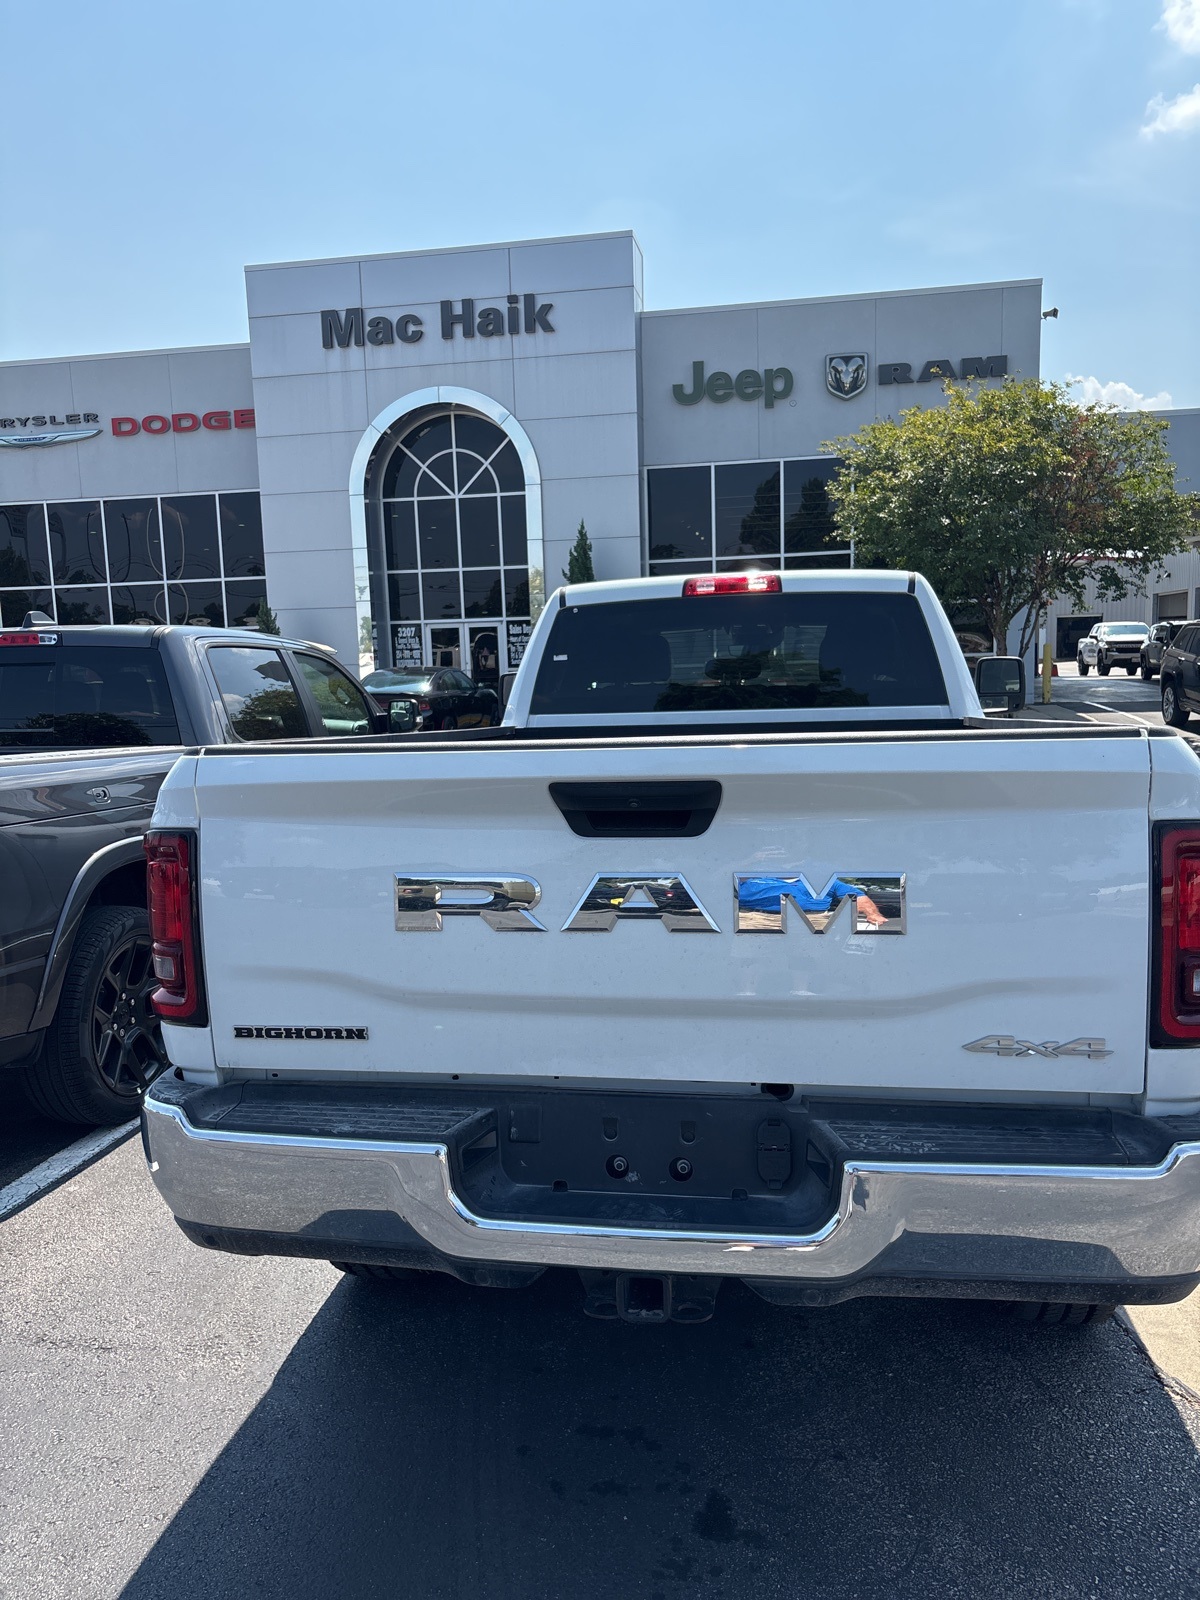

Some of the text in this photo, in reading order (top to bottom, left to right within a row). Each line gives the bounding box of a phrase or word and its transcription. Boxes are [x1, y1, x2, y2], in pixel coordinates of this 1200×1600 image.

[320, 293, 555, 349] Mac Haik
[672, 360, 794, 409] Jeep
[878, 355, 1008, 386] RAM
[111, 408, 255, 437] DODGE
[397, 627, 416, 637] 3207
[394, 871, 907, 935] RAM
[233, 1025, 369, 1040] BIGHORN
[961, 1034, 1115, 1059] 4x4
